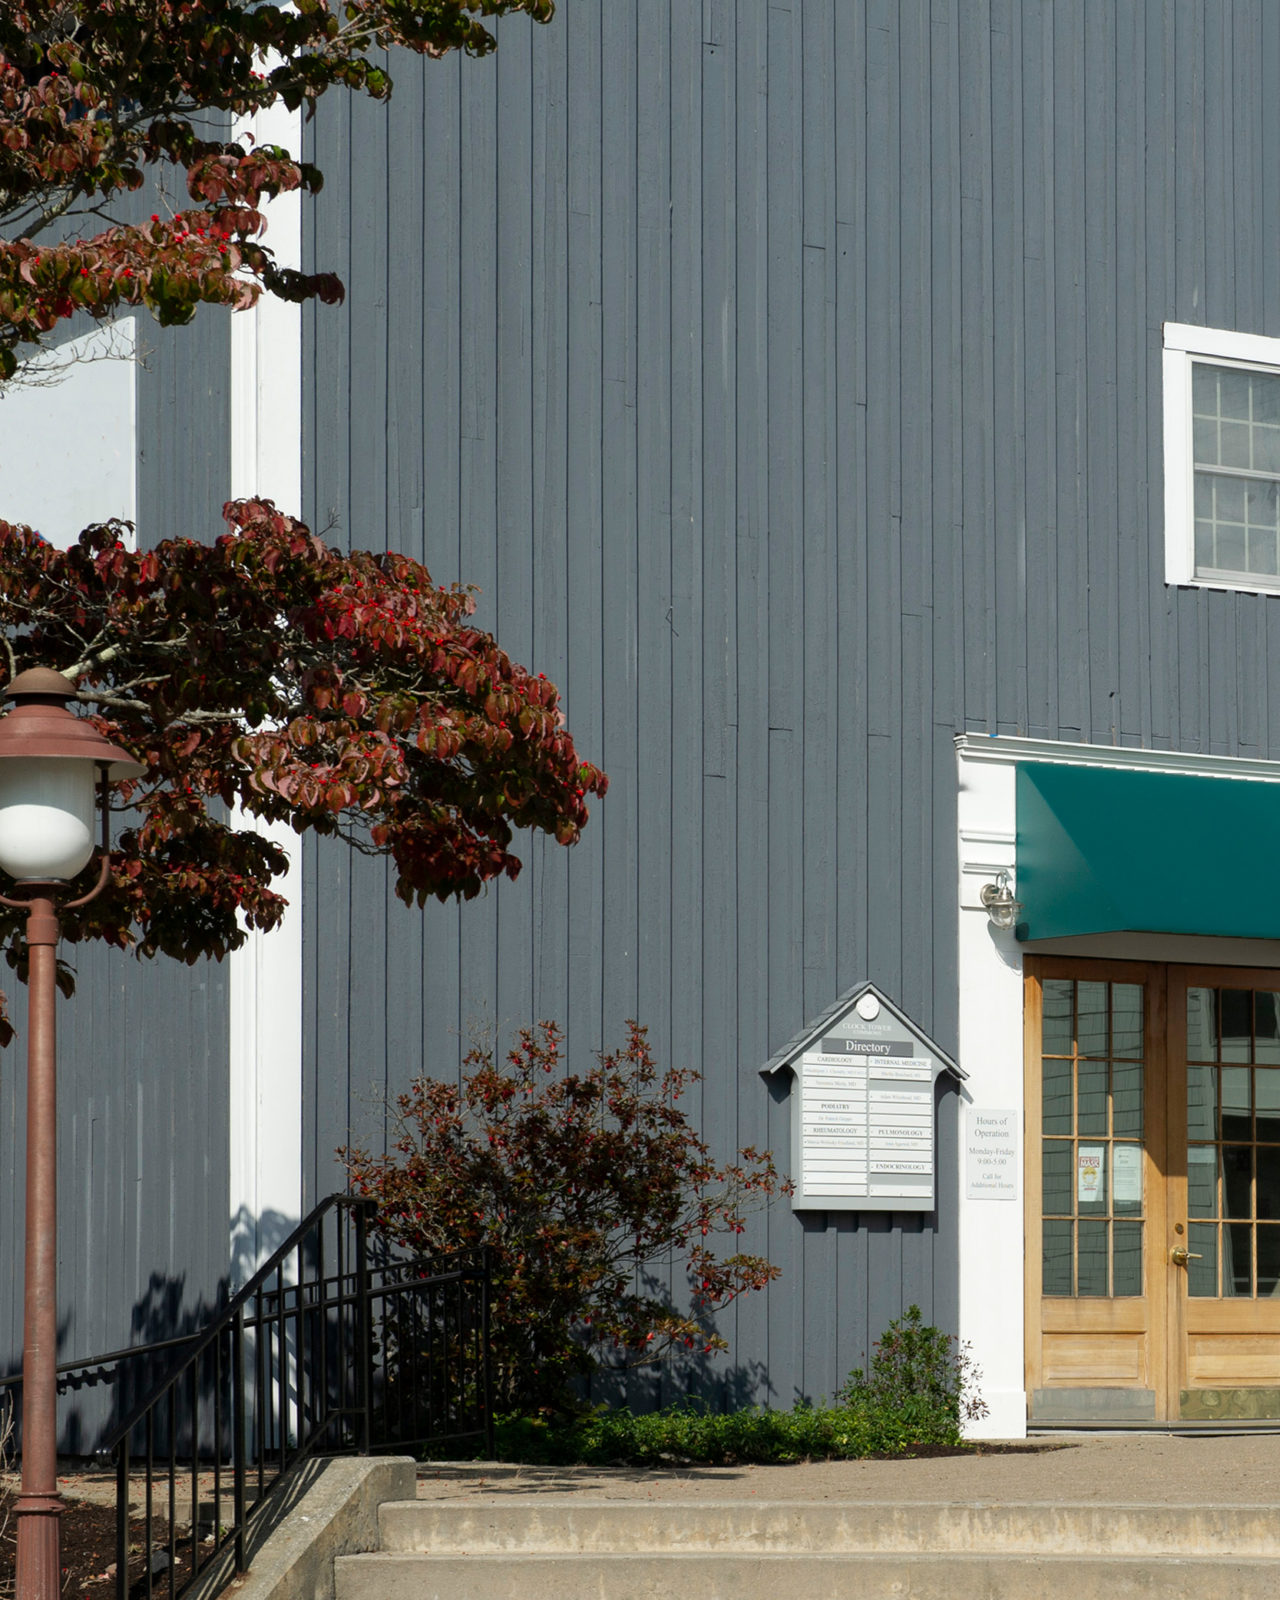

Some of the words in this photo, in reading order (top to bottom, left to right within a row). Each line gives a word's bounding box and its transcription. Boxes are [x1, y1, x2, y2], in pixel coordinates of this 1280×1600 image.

[842, 1023, 866, 1031] CLOCK
[868, 1023, 892, 1031] TOWER
[846, 1041, 891, 1055] Directory
[874, 1058, 900, 1066] INTERNAL
[902, 1059, 928, 1067] MEDICINE
[976, 1117, 998, 1125] Hours
[999, 1117, 1008, 1126] of
[878, 1129, 923, 1137] PULMONOLOGY
[974, 1129, 1009, 1139] Operation
[968, 1147, 1015, 1157] Monday-Friday
[876, 1163, 925, 1171] ENDOCRINOLOGY
